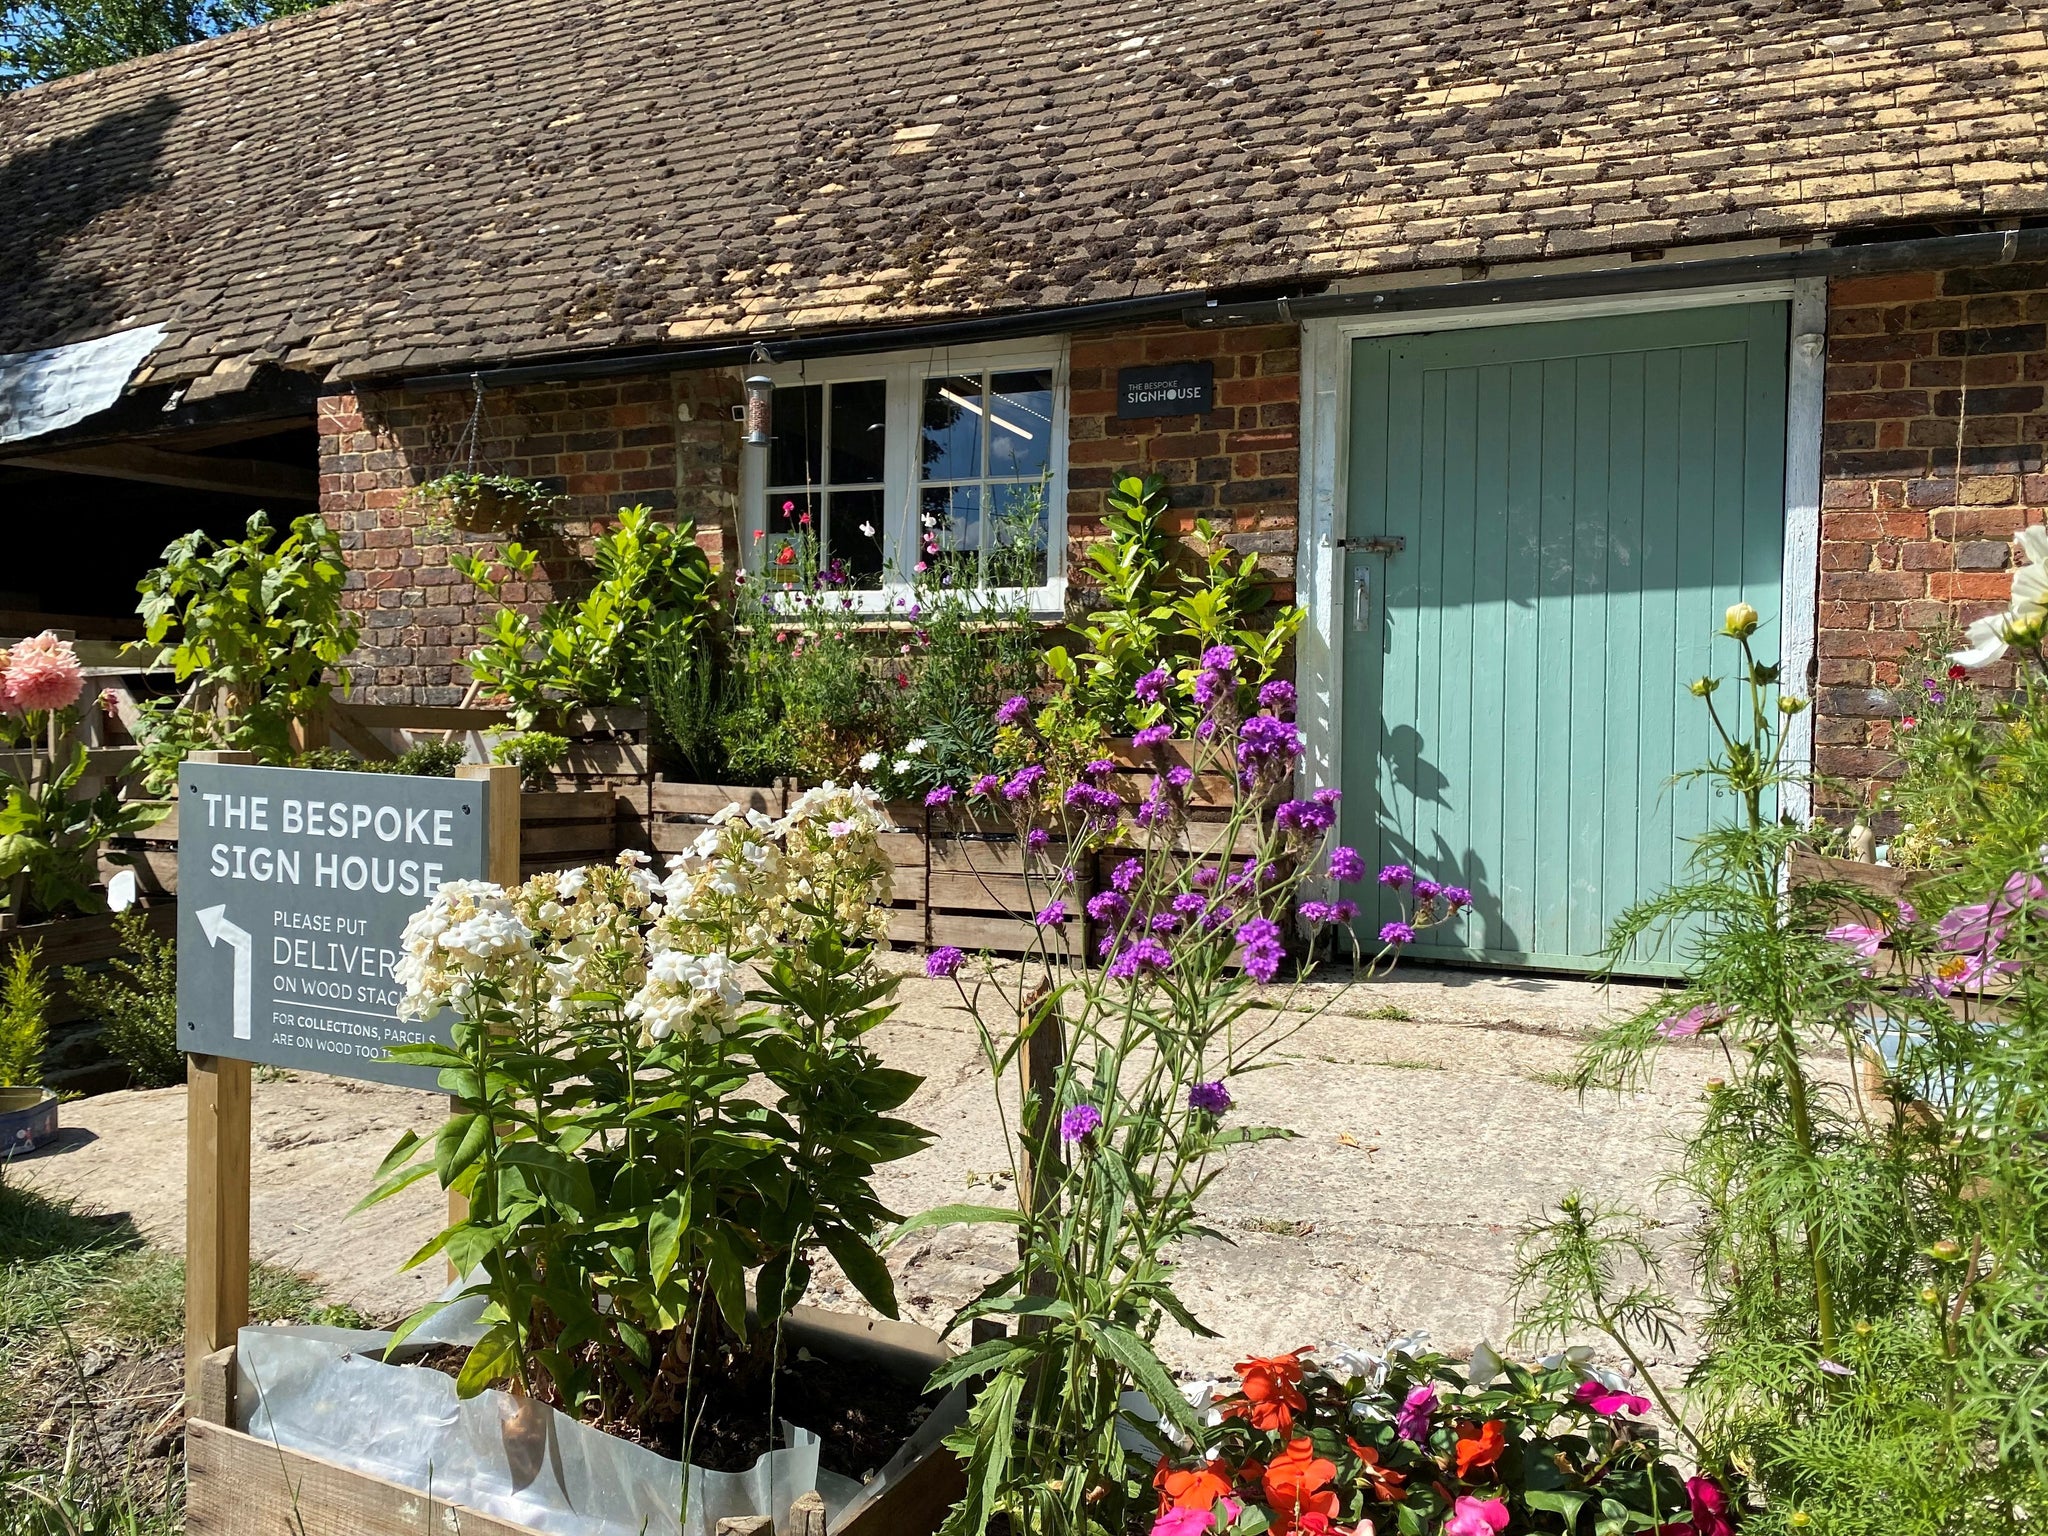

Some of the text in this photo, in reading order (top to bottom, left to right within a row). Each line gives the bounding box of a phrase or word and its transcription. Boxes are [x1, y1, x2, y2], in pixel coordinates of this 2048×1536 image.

[1128, 380, 1178, 391] THE BESPOKE
[202, 793, 453, 846] THE BESPOKE
[210, 843, 443, 898] SIGN HOUSE
[274, 910, 367, 936] PLEASE PUT
[273, 936, 412, 979] DELIVER
[273, 975, 297, 993] ON
[301, 978, 352, 1000] WOOD
[272, 1012, 294, 1026] FOR
[297, 1016, 381, 1041] COLLECTIONS,
[272, 1032, 294, 1046] ARE
[296, 1036, 313, 1049] ON
[316, 1039, 352, 1055] WOOD
[355, 1045, 379, 1058] TOO
